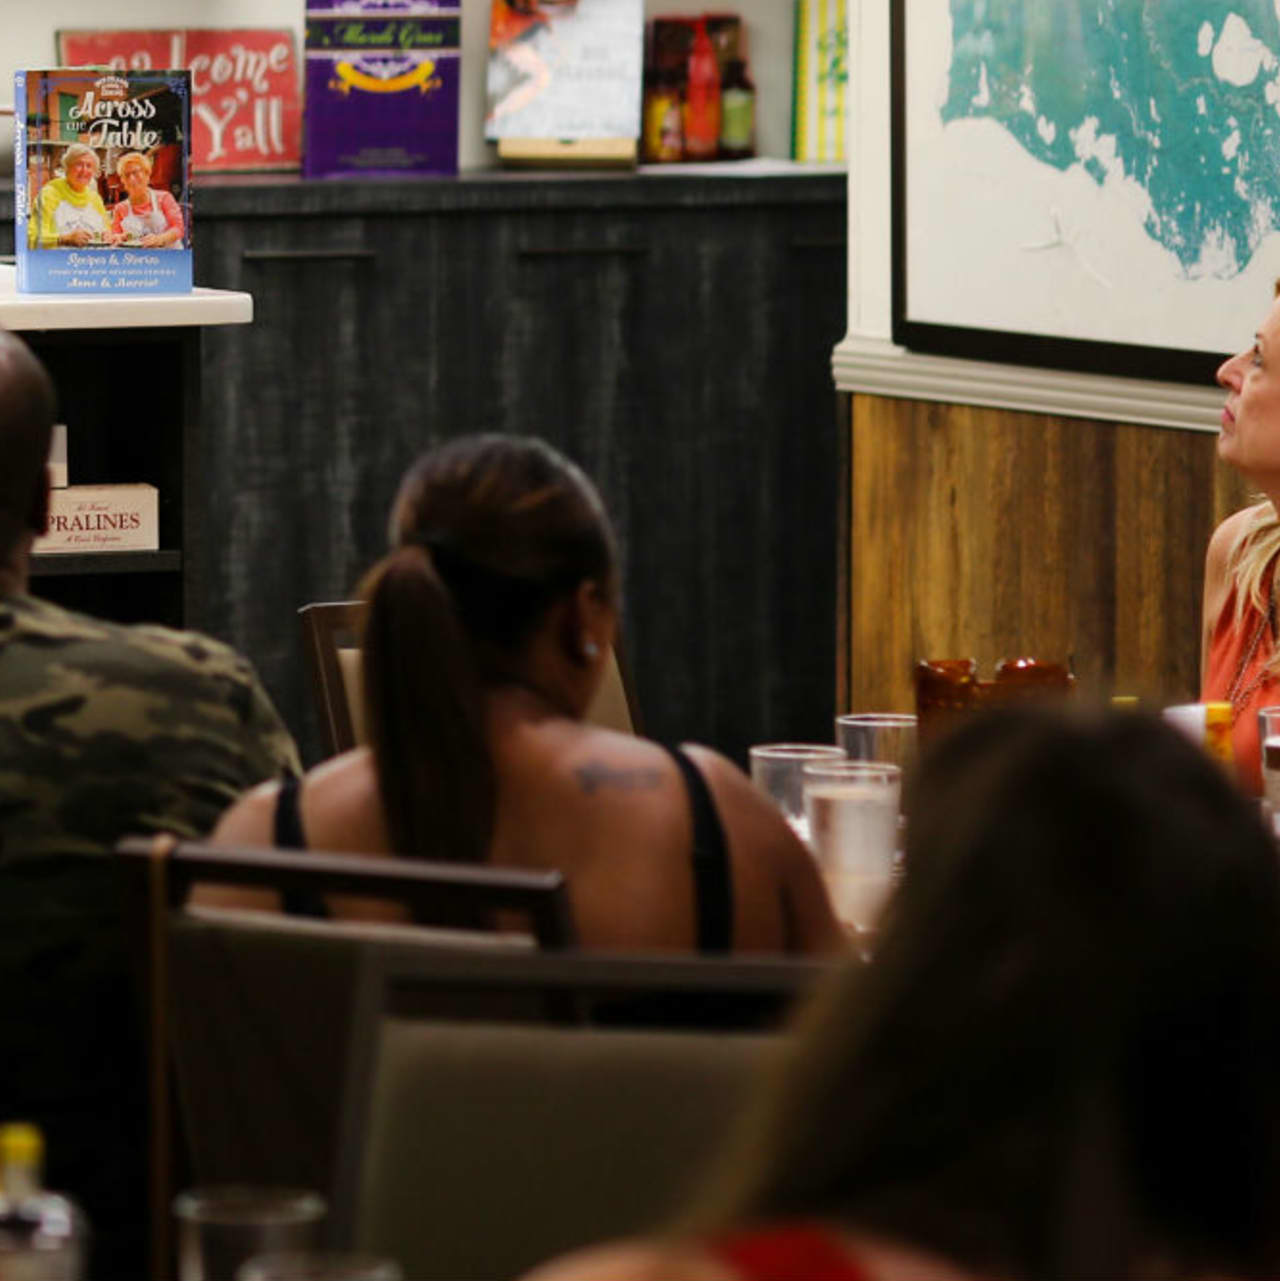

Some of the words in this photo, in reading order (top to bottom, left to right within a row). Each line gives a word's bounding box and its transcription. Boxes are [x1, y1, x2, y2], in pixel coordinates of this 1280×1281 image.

[68, 91, 157, 119] Across
[90, 118, 161, 150] Table
[192, 88, 285, 162] Y'all
